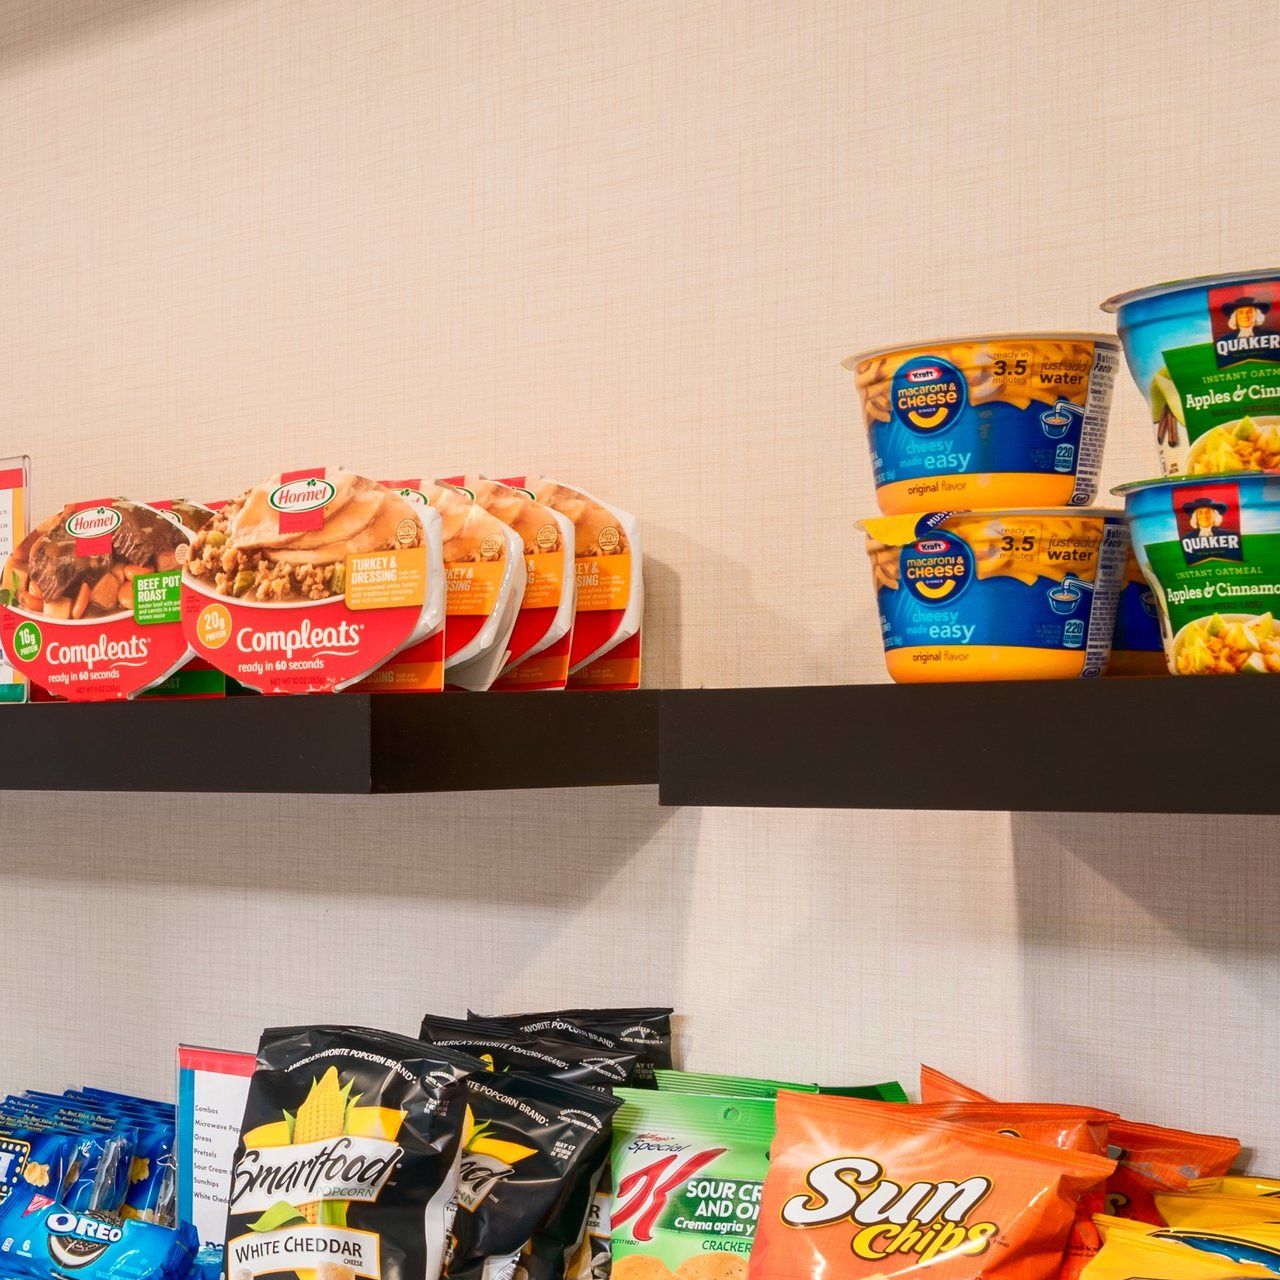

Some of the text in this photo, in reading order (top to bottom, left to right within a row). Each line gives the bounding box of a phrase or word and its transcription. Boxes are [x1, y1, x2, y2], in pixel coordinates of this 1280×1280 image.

[993, 360, 1028, 377] 3.5
[1040, 372, 1084, 385] water
[897, 383, 946, 398] macaroni
[1186, 391, 1231, 410] Apples
[906, 439, 954, 455] cheesy
[924, 452, 971, 472] easy
[277, 485, 328, 506] Hormel
[908, 481, 939, 495] original
[74, 514, 115, 532] Hormel
[1001, 535, 1036, 552] 3.5
[1182, 534, 1239, 554] QUAKER
[906, 555, 955, 569] macaroni
[1047, 549, 1093, 562] water
[351, 557, 388, 571] TURKEY
[351, 569, 398, 584] DRESSING
[1176, 566, 1264, 580] INSTANT OATMEAL
[137, 575, 181, 591] BEEF POT
[137, 589, 167, 602] ROAST
[1167, 587, 1206, 606] Apples
[912, 609, 959, 626] cheesy
[236, 618, 360, 659] Compleats
[928, 623, 976, 643] easy
[45, 632, 148, 670] Compleats
[912, 651, 942, 664] original
[238, 658, 324, 674] ready seconds
[48, 669, 120, 685] ready seconds
[479, 1085, 519, 1107] POPCORN
[194, 1104, 219, 1115] Combos
[193, 1134, 213, 1143] Oreos
[628, 1138, 692, 1153] Special
[193, 1148, 218, 1159] Pretzels
[193, 1162, 229, 1176] Sour Cream
[231, 1137, 402, 1200] Smartfood
[193, 1177, 220, 1189] Sunchips
[686, 1180, 736, 1200] SOUR
[193, 1191, 211, 1202] White
[316, 1186, 376, 1199] POPCORN
[781, 1157, 994, 1228] Sun
[695, 1200, 738, 1218] AND
[46, 1213, 124, 1244] OREO
[674, 1217, 744, 1236] Crema agria
[235, 1235, 363, 1264] WHITE CHEDDAR
[343, 1257, 364, 1268] CHEESE
